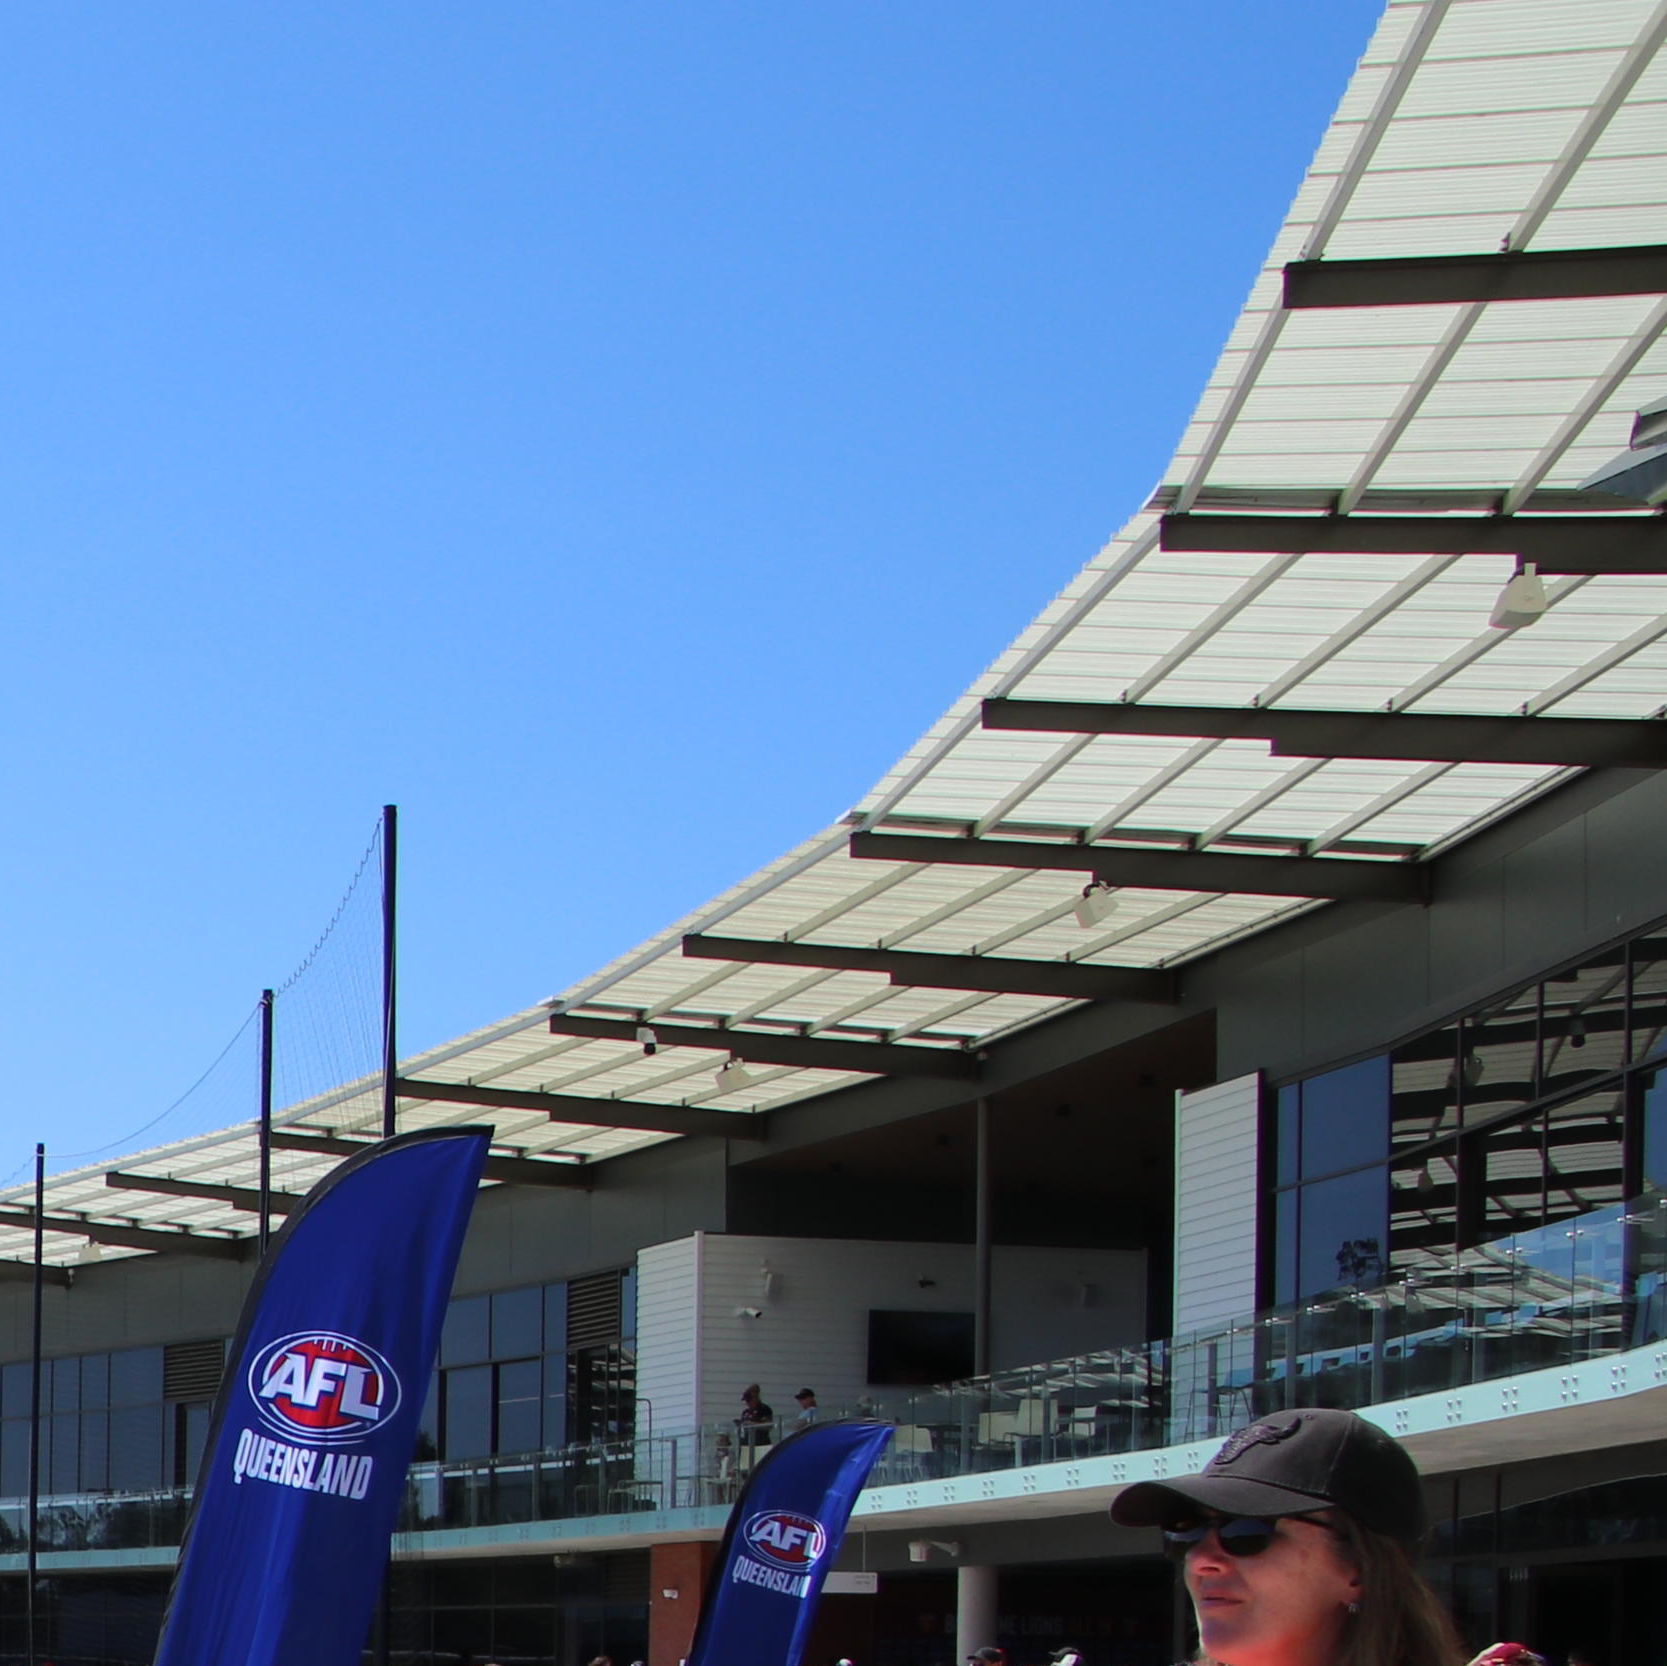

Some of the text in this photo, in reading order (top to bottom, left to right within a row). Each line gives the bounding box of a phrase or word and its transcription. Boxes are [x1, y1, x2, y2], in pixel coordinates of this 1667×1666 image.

[258, 1352, 379, 1421] AFL
[233, 1428, 373, 1500] QUEENSLAND
[749, 1519, 818, 1559] AFL
